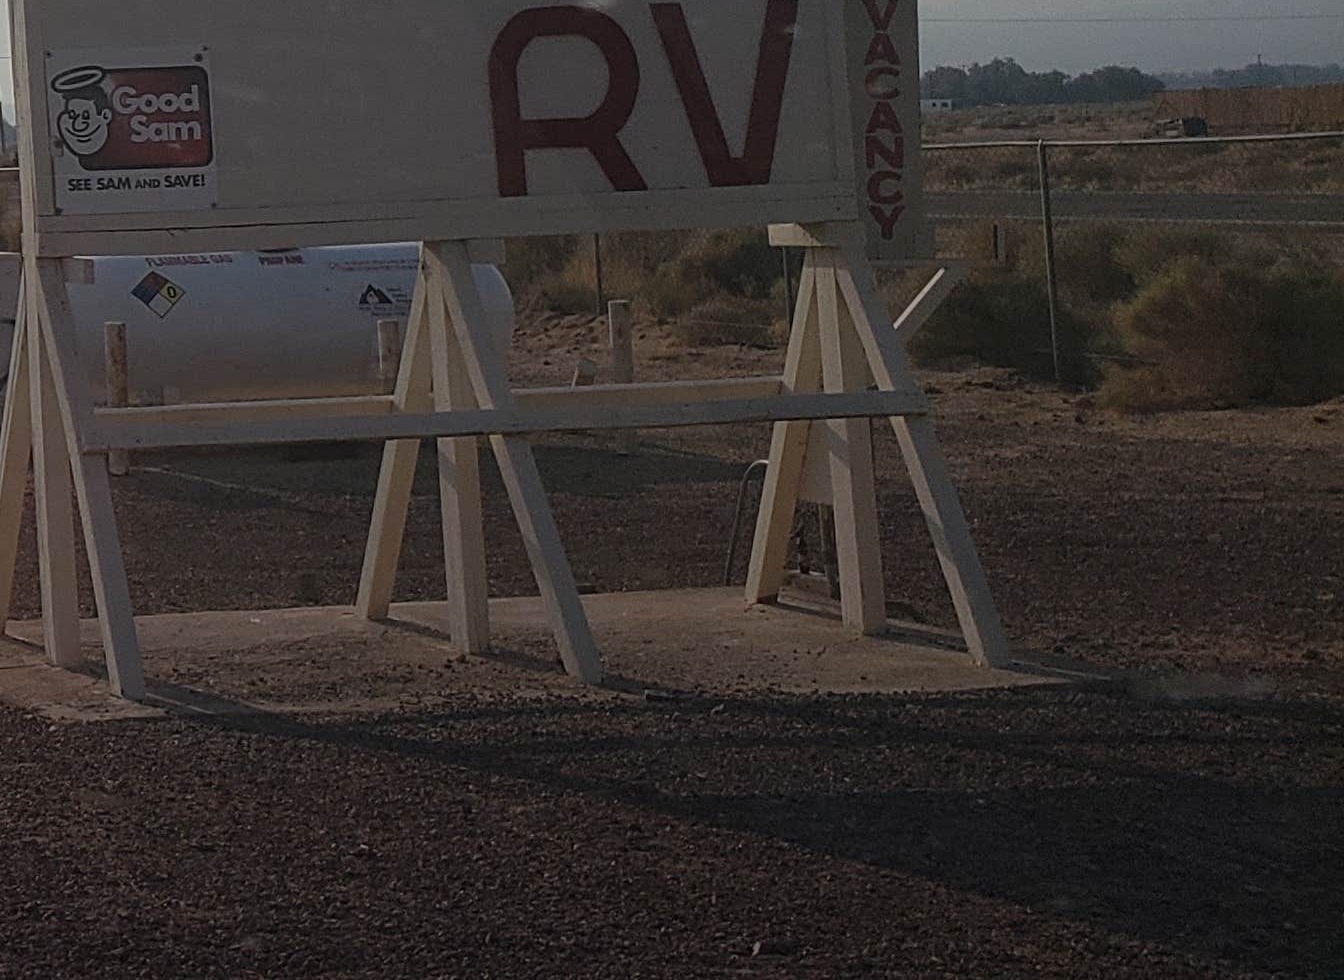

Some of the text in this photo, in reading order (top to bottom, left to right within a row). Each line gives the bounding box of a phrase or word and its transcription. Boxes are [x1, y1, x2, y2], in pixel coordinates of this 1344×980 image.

[112, 85, 200, 114] Good
[130, 115, 201, 143] Sam
[67, 174, 206, 192] SEE SAM AND SAVE!
[166, 285, 177, 299] 0
